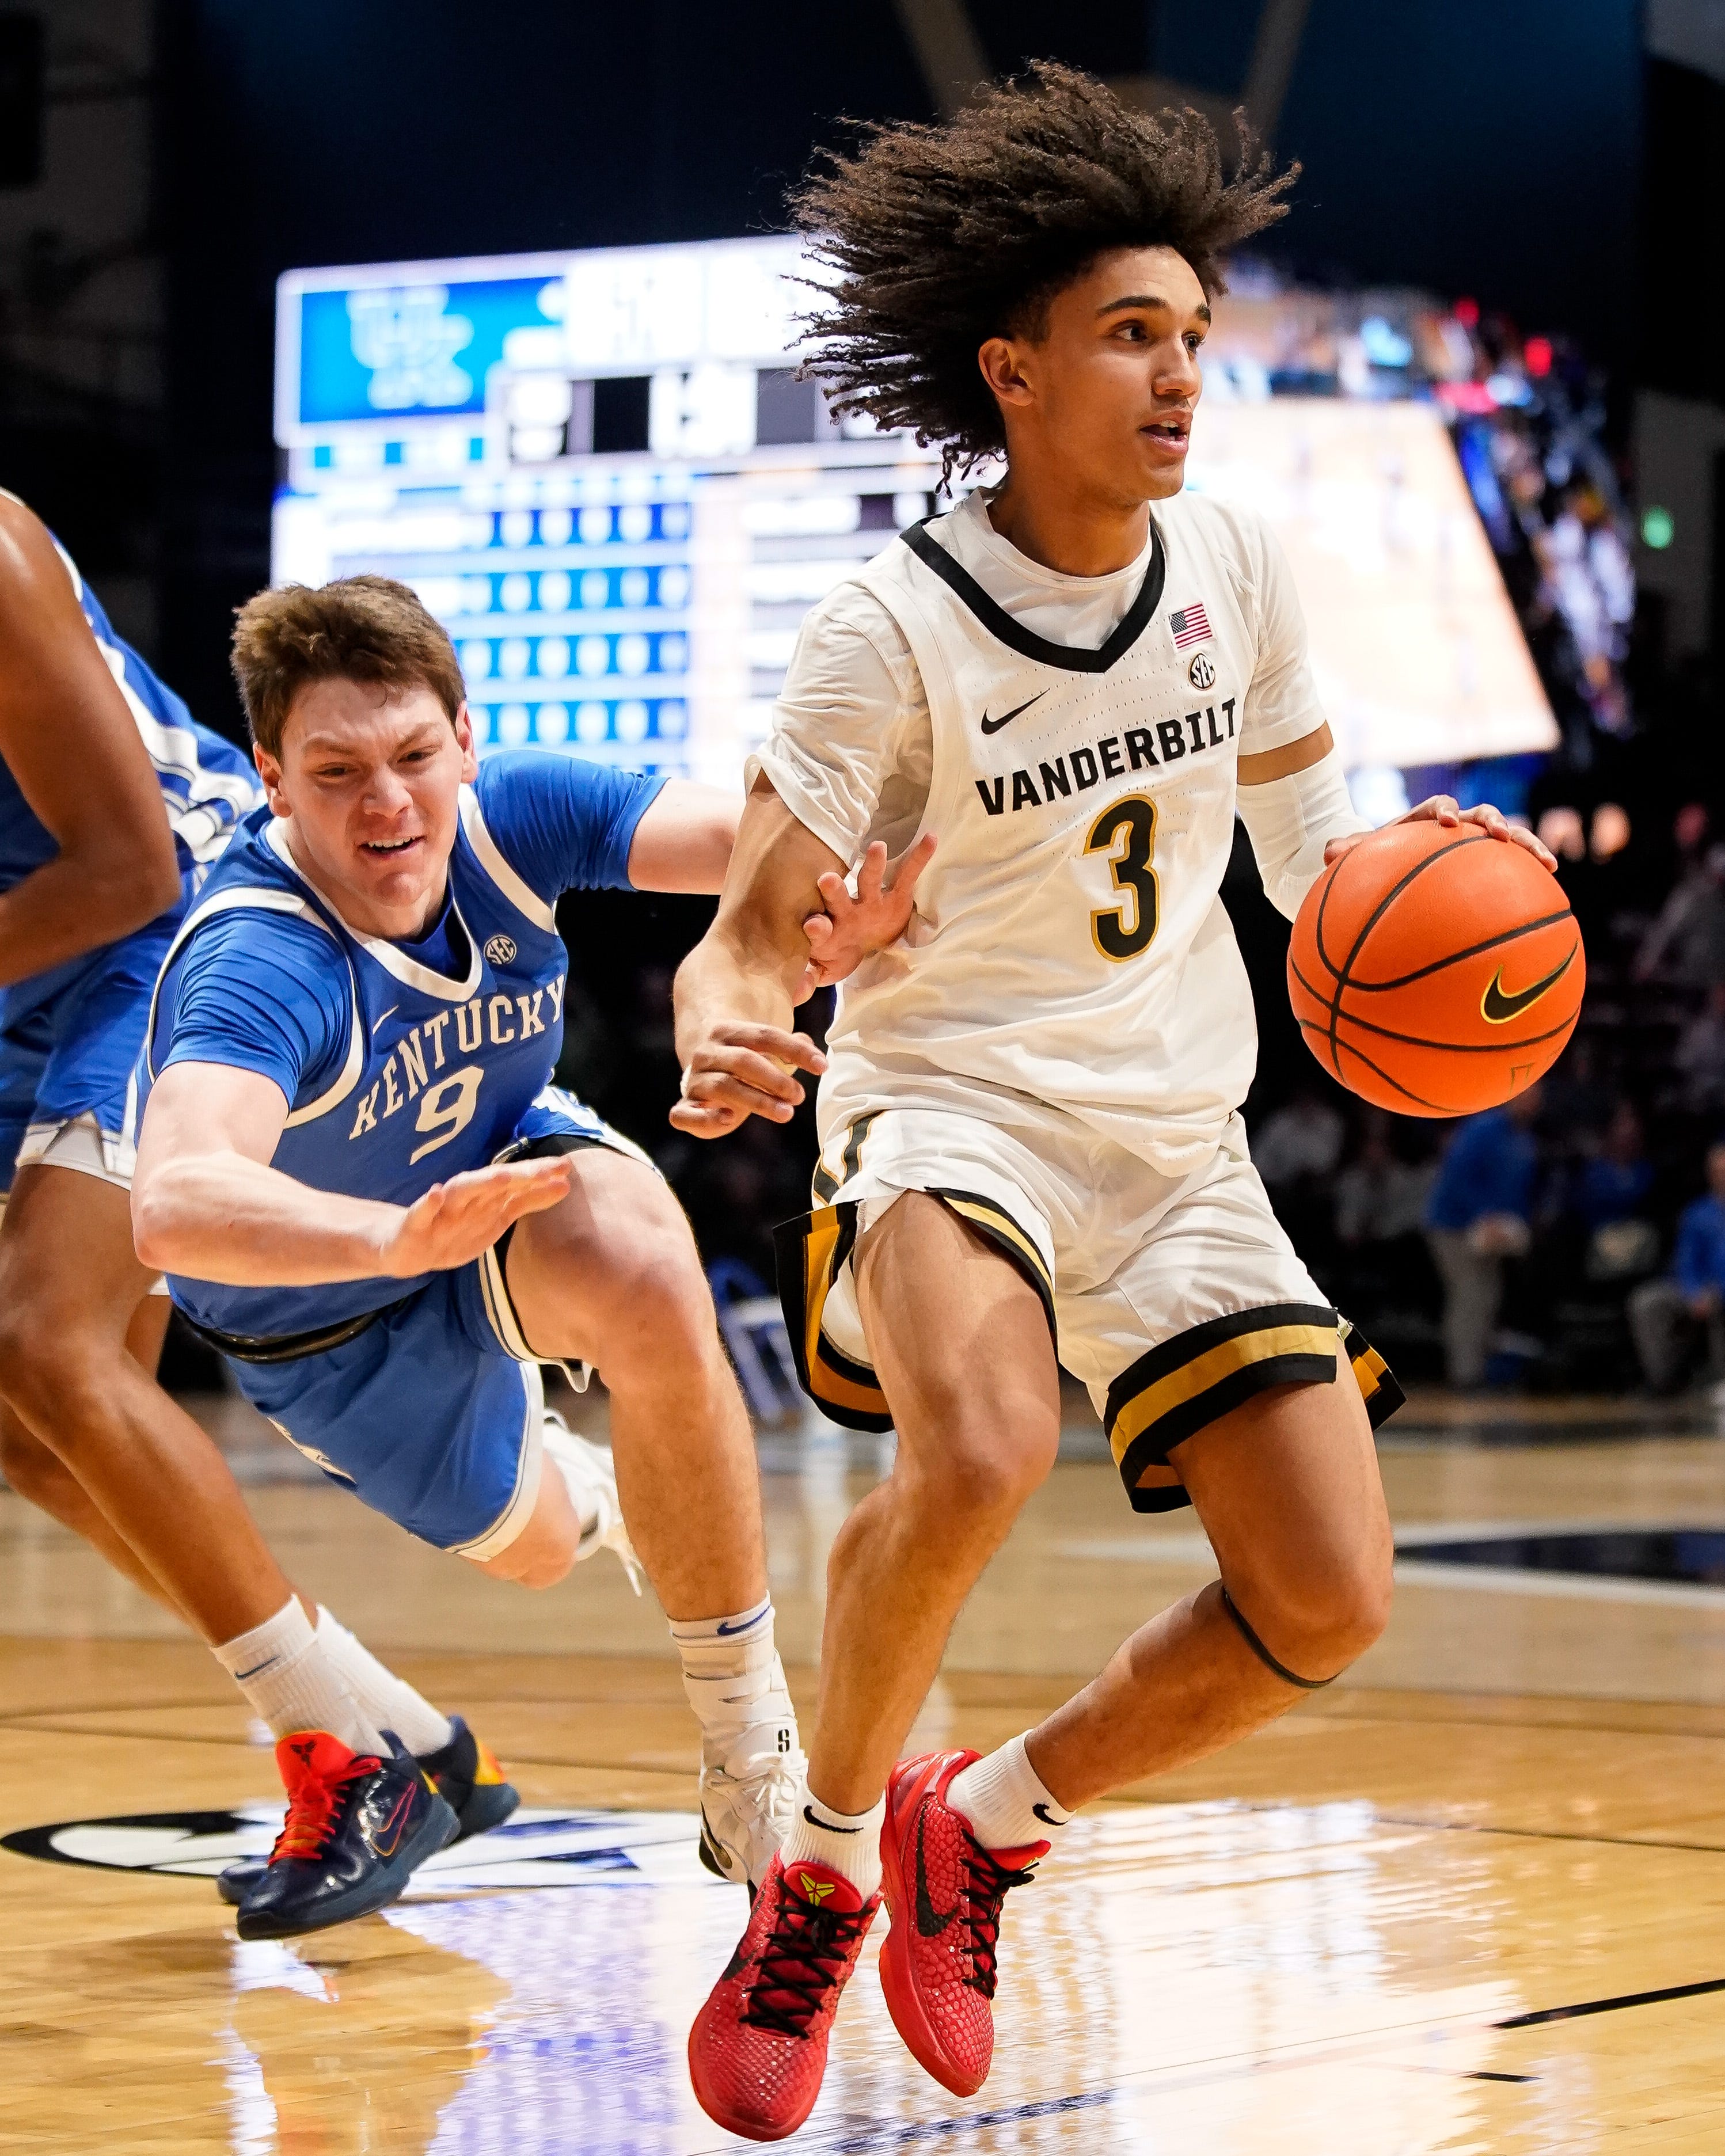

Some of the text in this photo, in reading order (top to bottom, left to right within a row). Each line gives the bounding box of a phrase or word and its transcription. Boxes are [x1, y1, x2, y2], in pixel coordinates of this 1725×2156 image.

[1190, 654, 1215, 688] SEC
[975, 698, 1237, 816] VANDERBILT
[1082, 793, 1160, 964] 3
[487, 938, 514, 965] SEC
[348, 974, 565, 1140] KENTUCKY
[409, 1065, 484, 1166] 9
